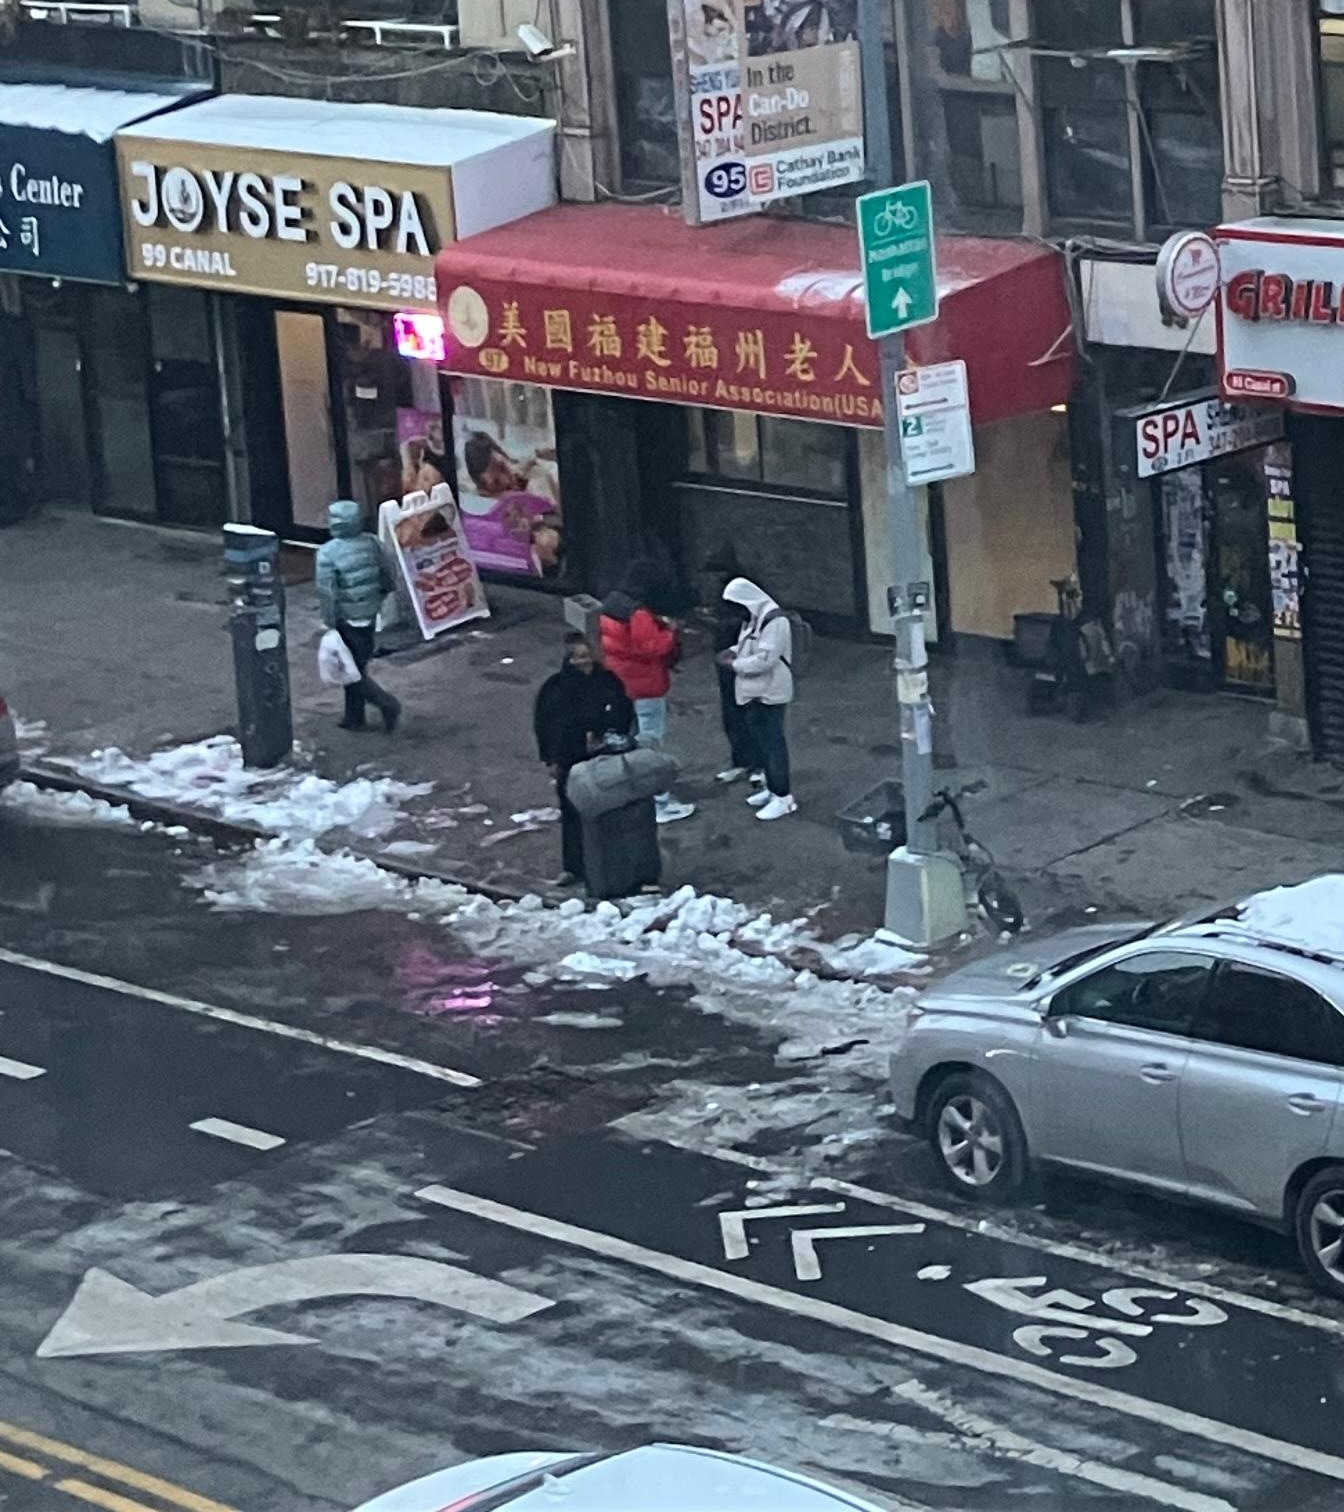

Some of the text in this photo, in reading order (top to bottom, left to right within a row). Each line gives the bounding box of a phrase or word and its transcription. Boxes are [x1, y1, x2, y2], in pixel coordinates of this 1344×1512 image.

[768, 61, 795, 83] the
[699, 93, 744, 135] SPA
[749, 87, 810, 116] Can-Do
[775, 144, 862, 175] Cathay Bank
[10, 162, 85, 209] Center
[711, 166, 747, 192] 95
[776, 166, 851, 192] Foundation
[130, 160, 430, 257] JOYSE SPA
[141, 243, 237, 277] 99 CANAL
[498, 301, 918, 388] 美國福建福州老人
[524, 356, 563, 379] New
[568, 361, 638, 388] Fuzhou
[645, 370, 708, 396] Senior
[1141, 408, 1202, 460] SPA
